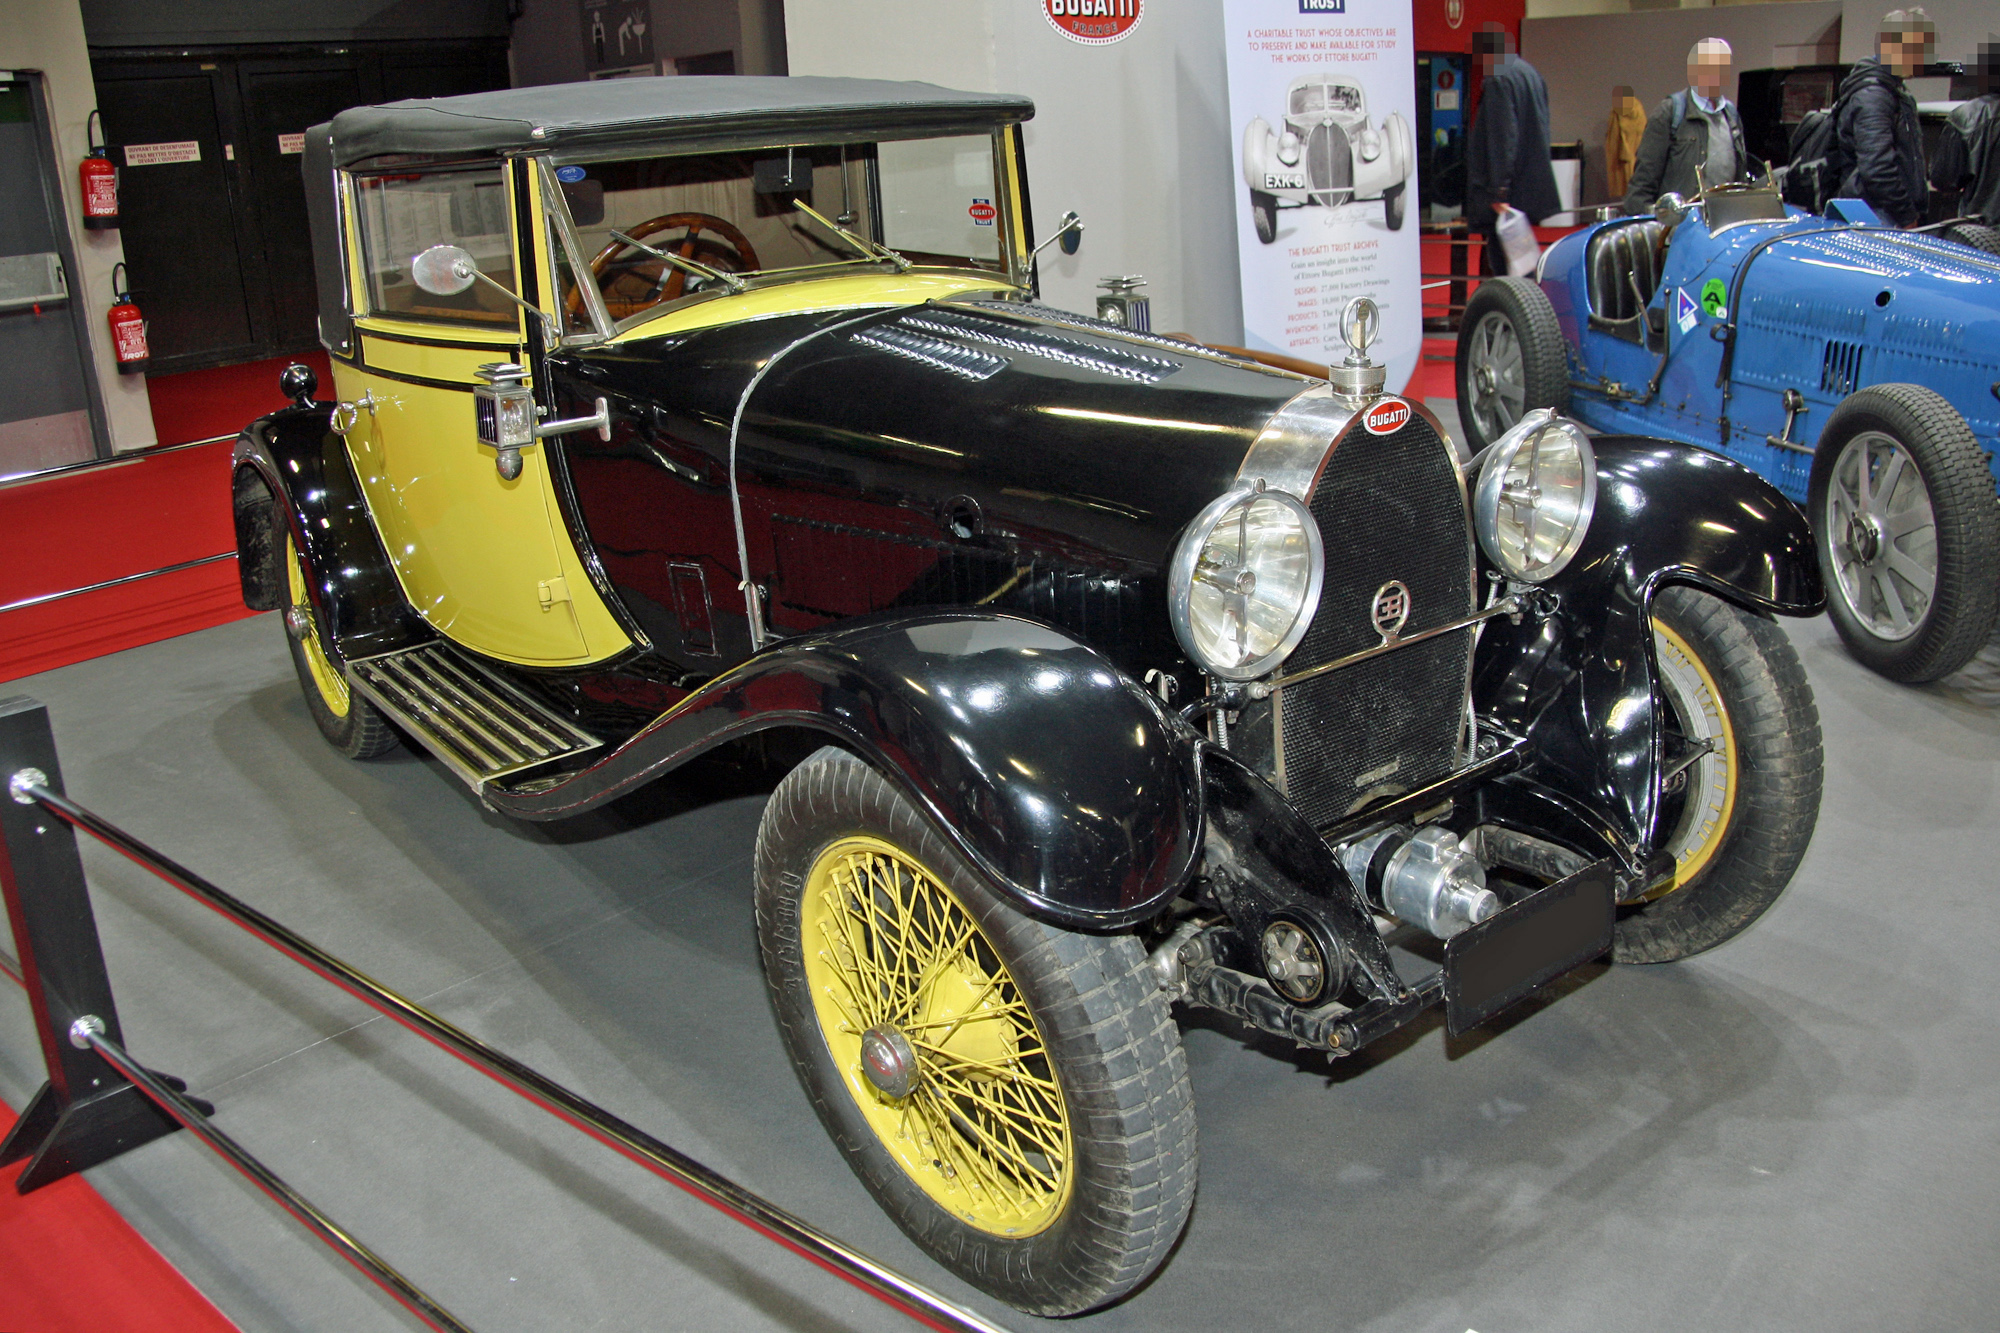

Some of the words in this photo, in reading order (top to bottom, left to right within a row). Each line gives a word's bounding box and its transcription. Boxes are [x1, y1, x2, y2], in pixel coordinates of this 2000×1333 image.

[1072, 21, 1118, 36] FRANCE
[1247, 30, 1252, 38] A
[1254, 29, 1293, 38] CHARITABLE
[1295, 29, 1315, 37] TRUST
[1318, 28, 1342, 37] WHOSE
[1344, 28, 1383, 37] OBJECTIVES
[1386, 28, 1396, 37] ARE
[1248, 42, 1259, 51] TO
[1261, 41, 1292, 51] PRESERVE
[1295, 41, 1308, 50] AND
[1310, 41, 1326, 50] MAKE
[1329, 40, 1359, 50] AVAILABLE
[1361, 40, 1375, 49] FOR
[1377, 40, 1396, 49] STUDY
[1271, 54, 1284, 63] THE
[1286, 53, 1310, 63] WORKS
[1312, 53, 1323, 62] OF
[1325, 53, 1349, 62] ETTORE
[1351, 52, 1378, 62] BUGATTI
[127, 145, 152, 153] OUVRANT
[1288, 247, 1300, 257] THE
[1302, 244, 1330, 256] BUGATTI
[1331, 242, 1351, 252] TRUST
[1353, 239, 1379, 250] ARCHIVE
[1370, 408, 1407, 427] BUGATTI
